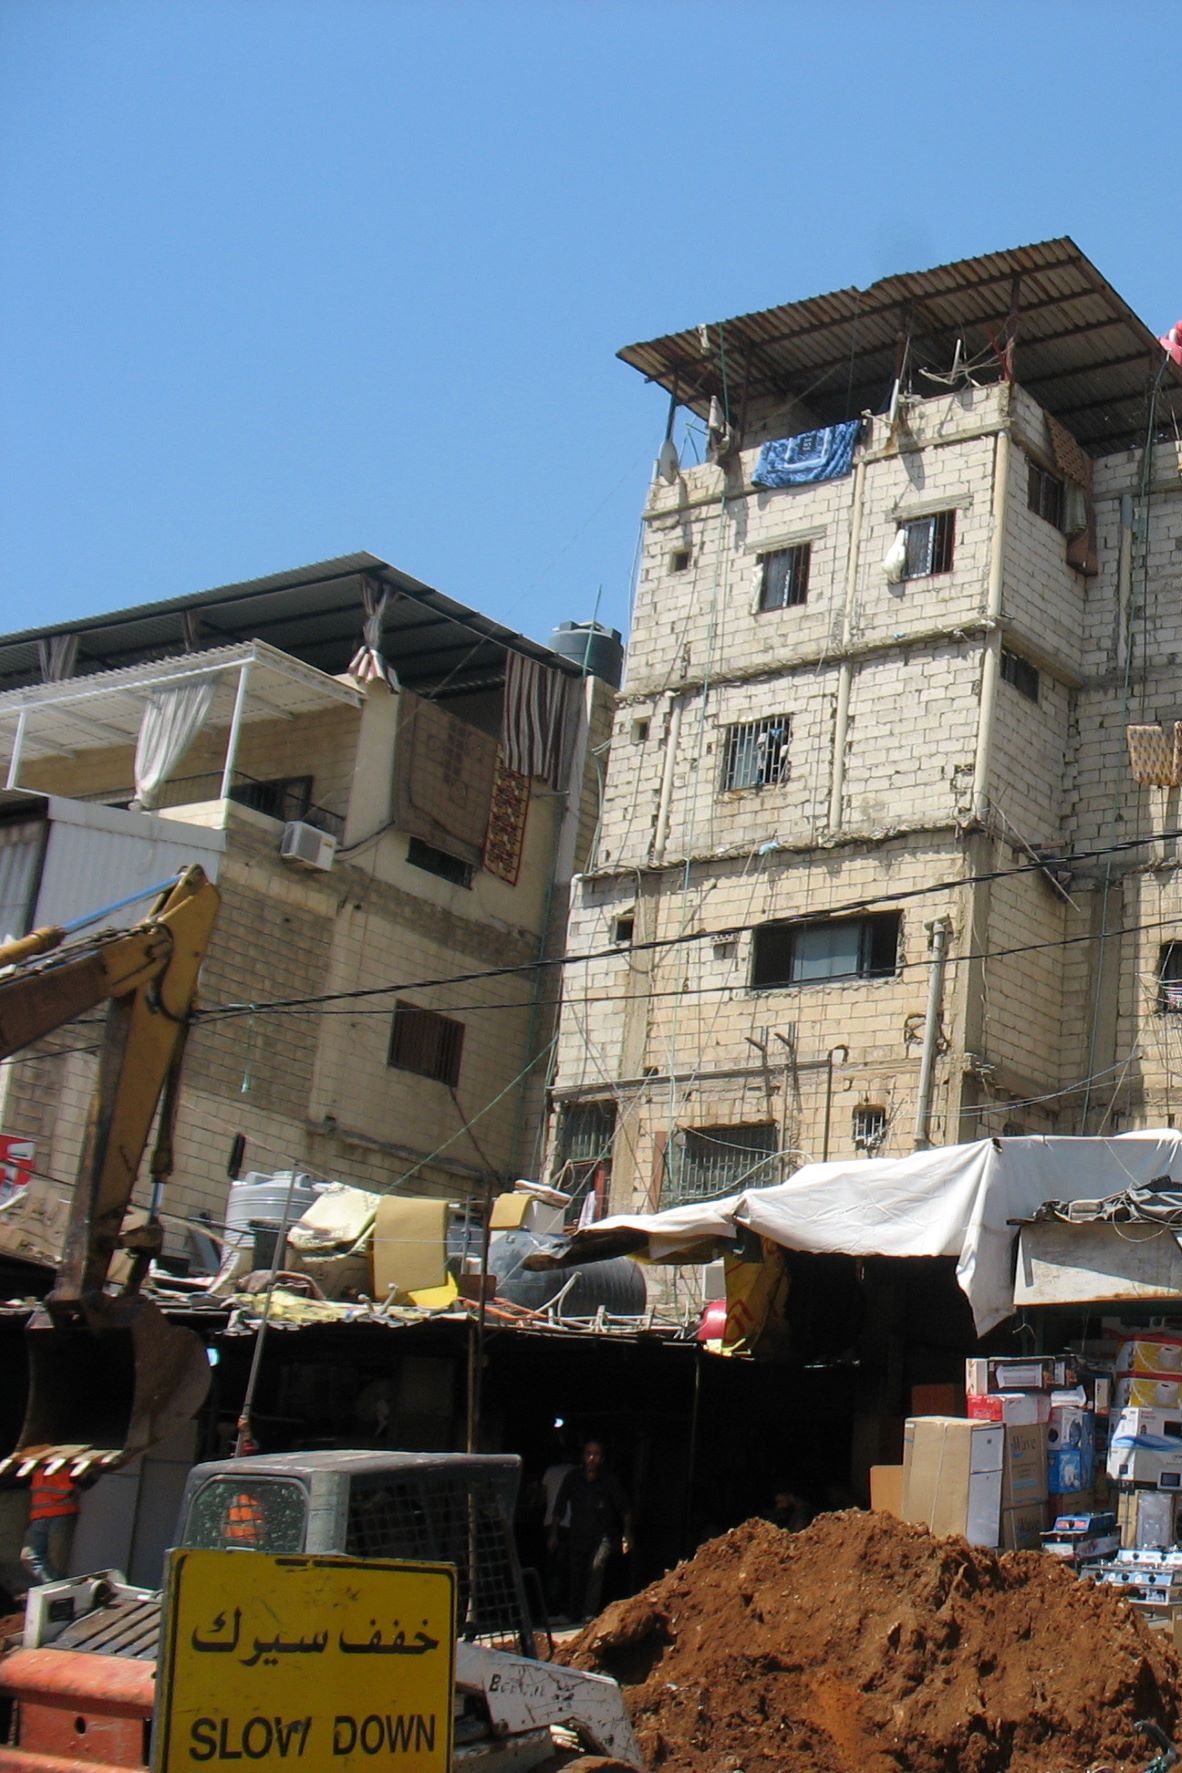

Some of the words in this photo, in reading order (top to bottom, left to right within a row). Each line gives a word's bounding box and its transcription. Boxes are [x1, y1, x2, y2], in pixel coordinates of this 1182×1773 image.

[191, 1606, 329, 1667] سيرك
[338, 1618, 440, 1654] خفف
[188, 1715, 312, 1762] SLOW
[333, 1714, 436, 1756] DOWN
